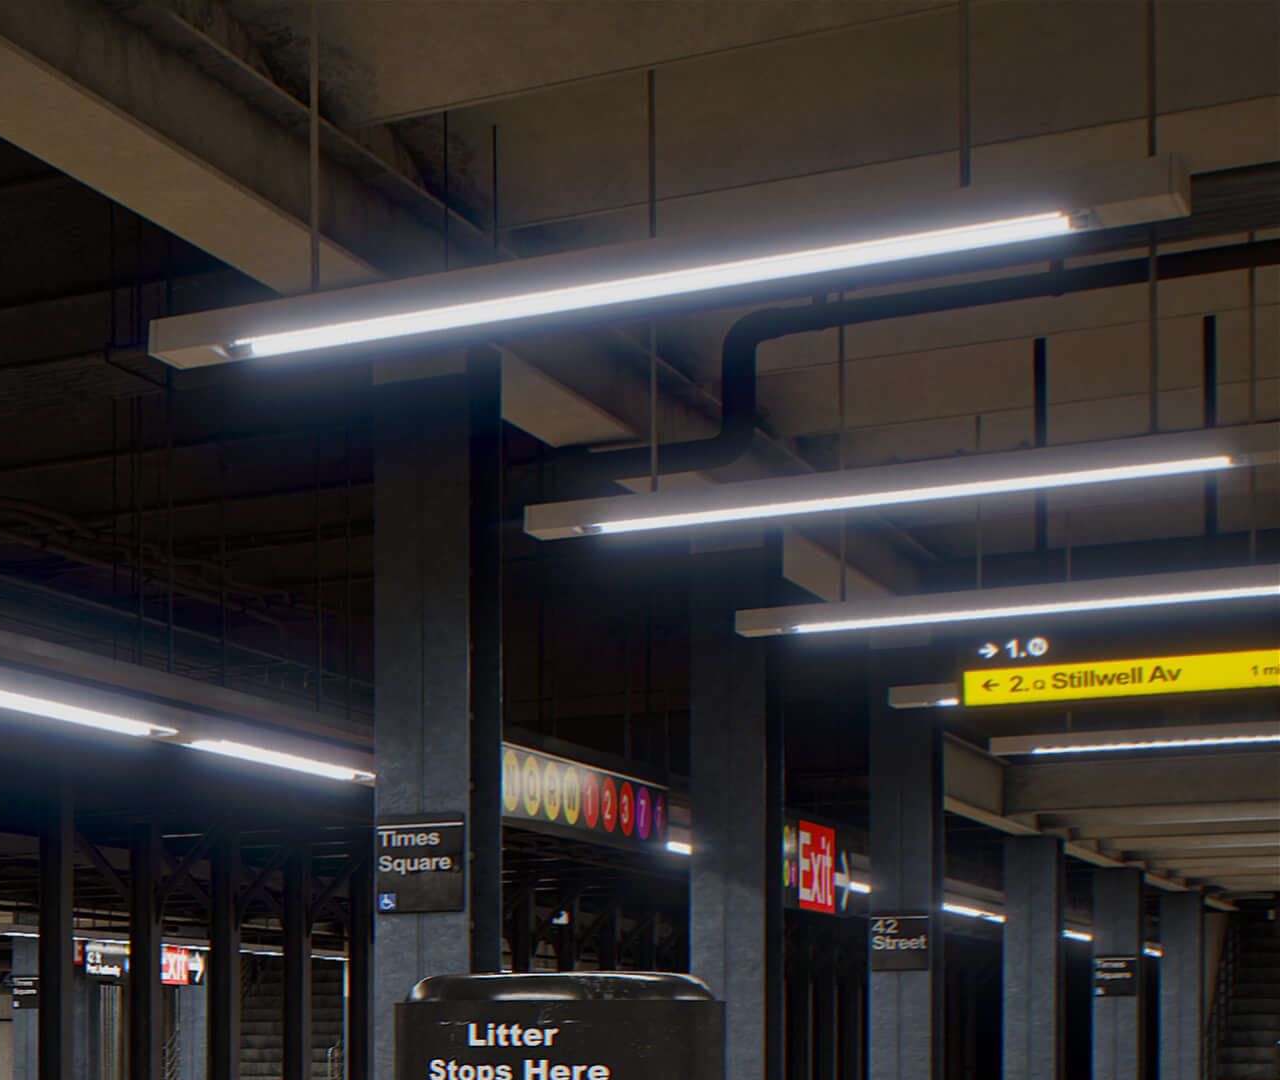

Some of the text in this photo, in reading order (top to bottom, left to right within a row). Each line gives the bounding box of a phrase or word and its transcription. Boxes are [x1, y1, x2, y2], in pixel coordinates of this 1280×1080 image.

[1052, 667, 1143, 690] Stillwell
[1149, 665, 1182, 684] Av
[377, 830, 441, 847] Times
[377, 855, 452, 875] Square
[799, 830, 832, 906] Exit
[871, 920, 899, 934] 42
[871, 935, 929, 950] Street
[468, 1023, 559, 1047] Litter
